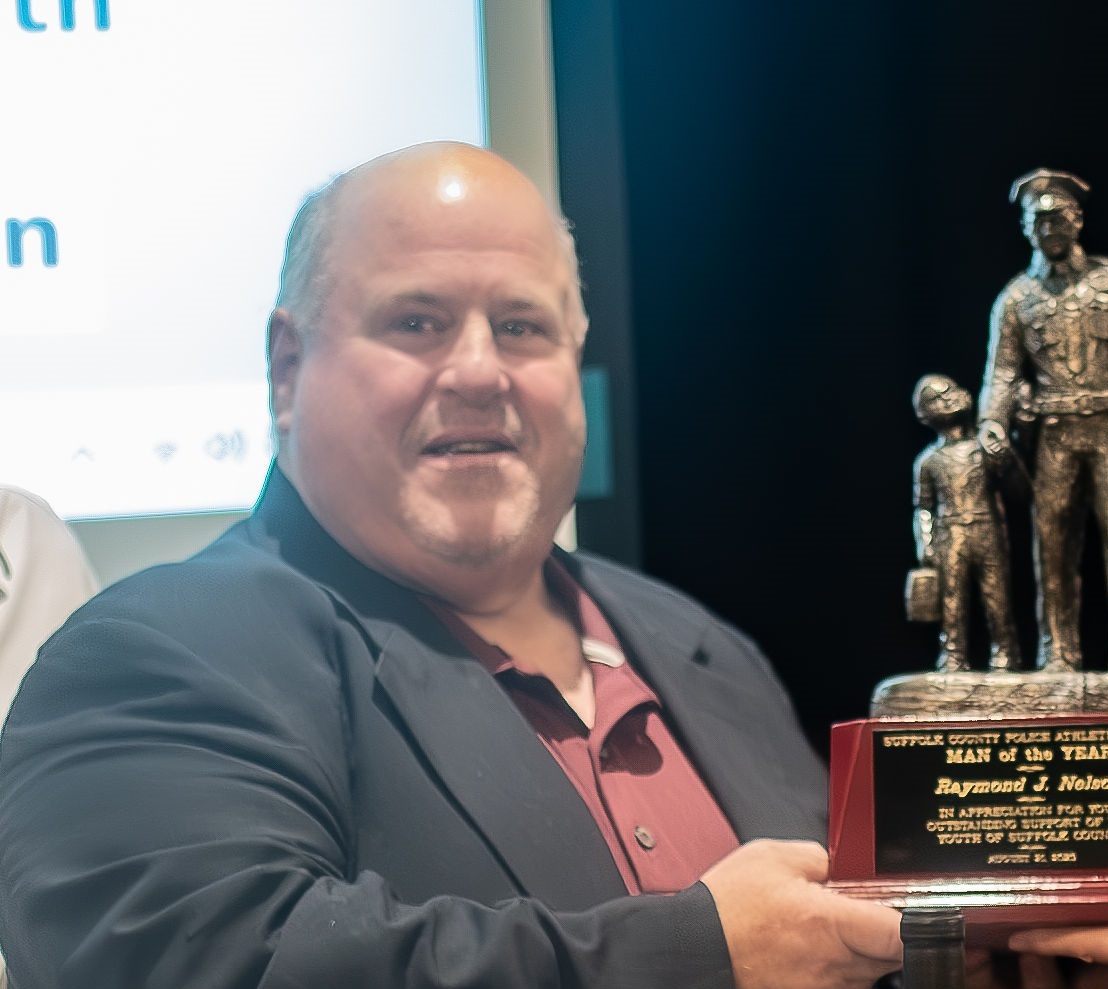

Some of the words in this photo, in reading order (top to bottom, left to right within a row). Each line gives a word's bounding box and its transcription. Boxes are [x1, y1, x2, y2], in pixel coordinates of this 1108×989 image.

[884, 735, 944, 747] SUFFOLK
[949, 734, 1000, 745] COUNTY
[1005, 732, 1050, 743] POLICE
[946, 748, 991, 763] MAN
[999, 748, 1017, 762] of
[1025, 747, 1052, 761] the
[935, 777, 1026, 797] Raymond
[1033, 776, 1048, 791] J.
[939, 808, 954, 818] IN
[959, 806, 1052, 818] APPRECIATION
[1057, 805, 1084, 815] FOR
[927, 820, 1016, 831] OUTSTANDING
[1022, 817, 1080, 829] SUPPORT
[1086, 817, 1103, 827] OF
[937, 833, 982, 844] YOUTH
[985, 833, 1003, 843] OF
[1009, 831, 1069, 842] SUFFOLK
